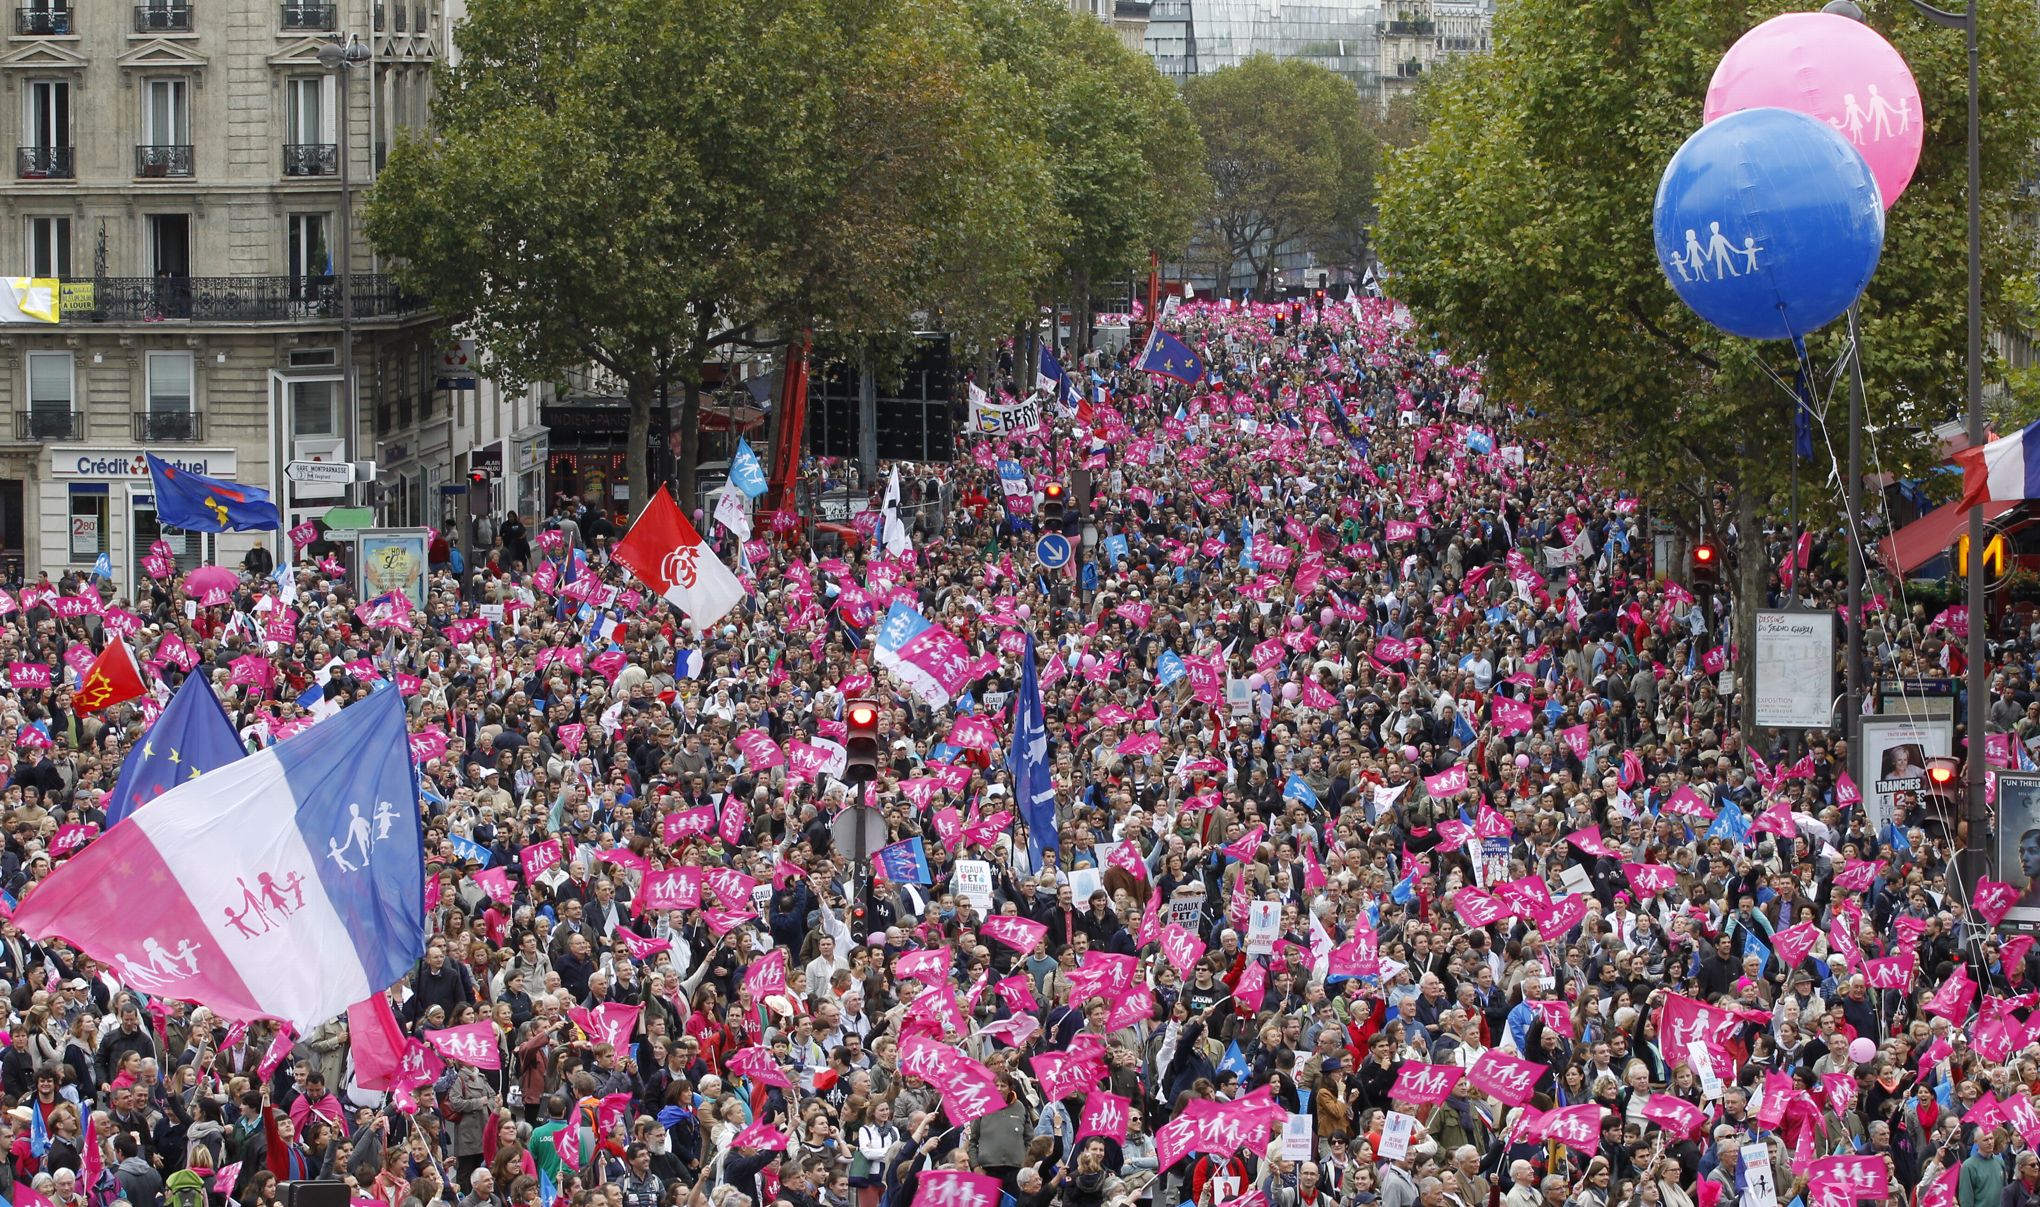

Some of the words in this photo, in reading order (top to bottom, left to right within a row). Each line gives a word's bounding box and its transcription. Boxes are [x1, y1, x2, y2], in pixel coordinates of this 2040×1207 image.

[77, 457, 129, 475] Crédit
[160, 458, 208, 475] tuel
[311, 466, 347, 474] MONTPARNASSE
[391, 547, 407, 556] HOW
[1877, 778, 1921, 793] TRANCHES
[960, 863, 984, 874] ÉGAUX
[968, 874, 978, 882] ET
[1172, 901, 1199, 912] ÉGAUX
[1179, 912, 1190, 920] ET
